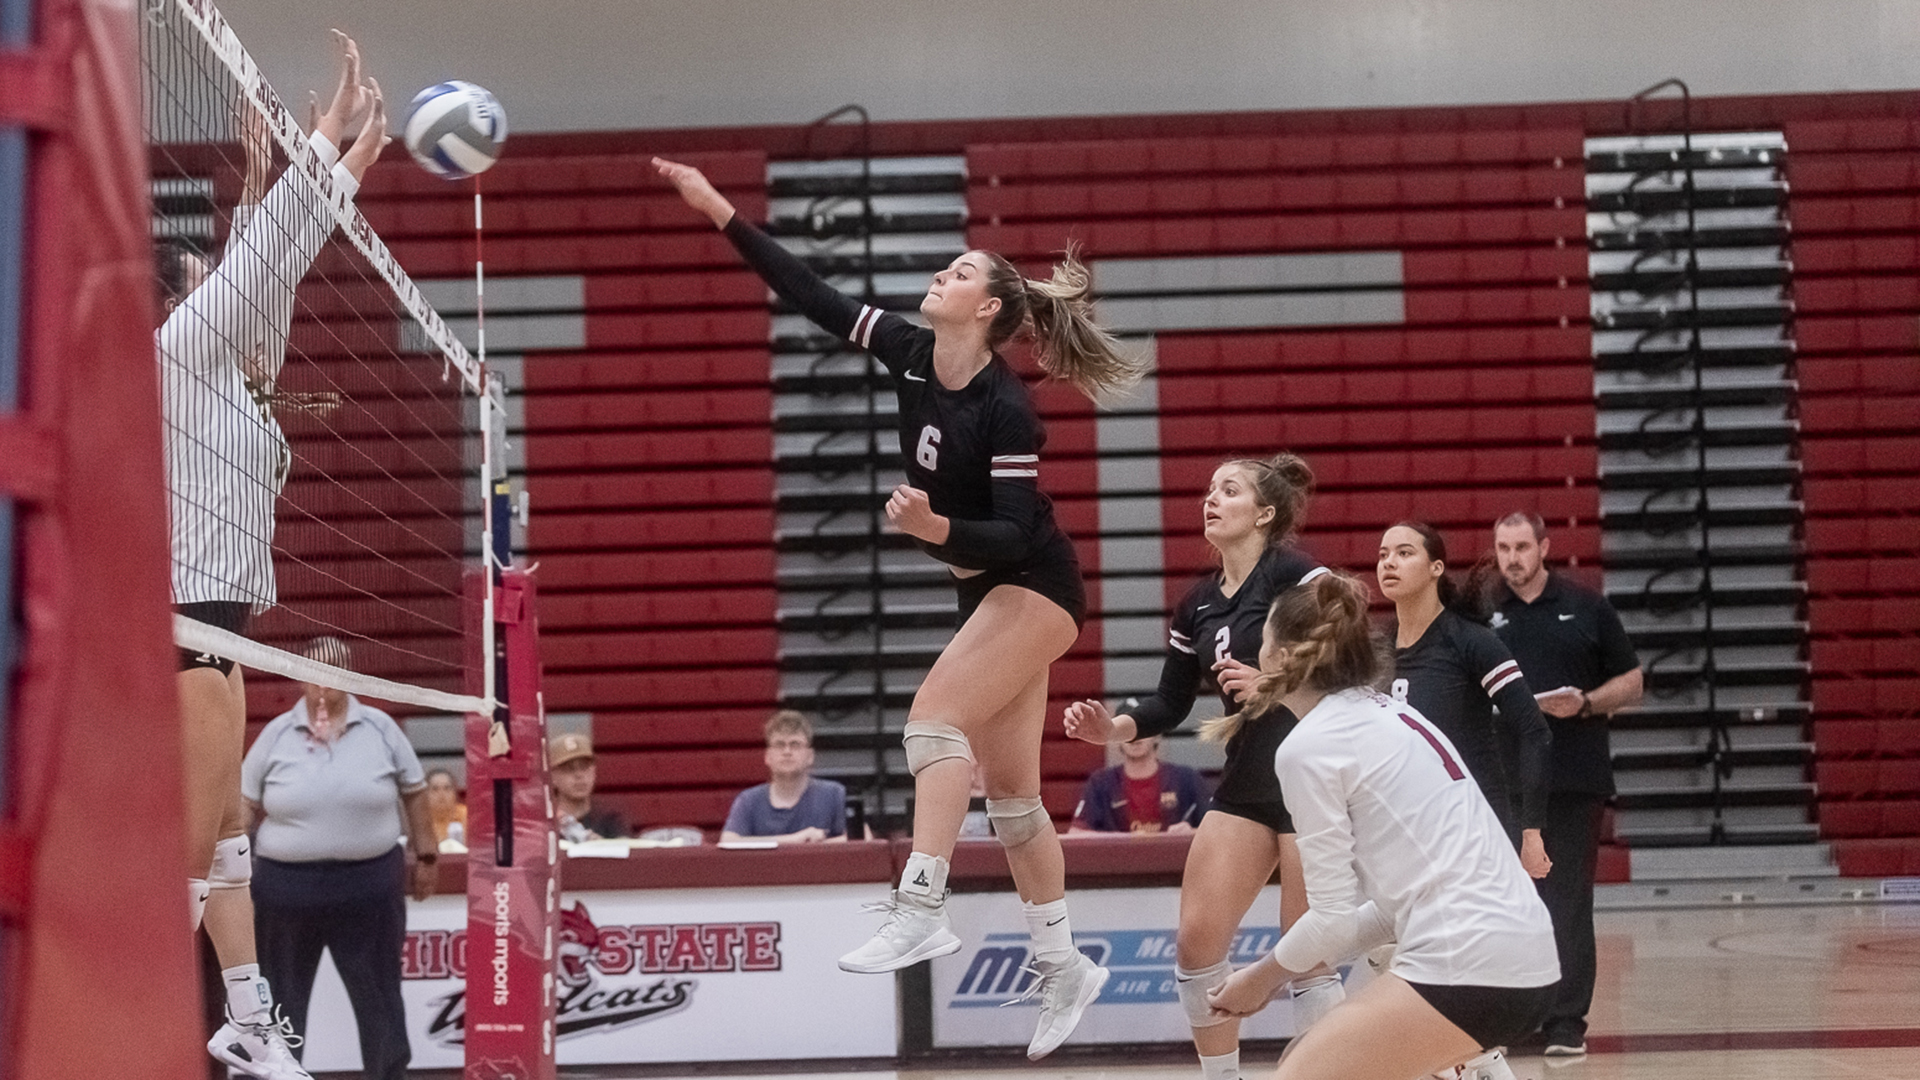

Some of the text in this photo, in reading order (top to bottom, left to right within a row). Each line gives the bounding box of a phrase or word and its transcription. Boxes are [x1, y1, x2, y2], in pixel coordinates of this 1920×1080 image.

[917, 424, 942, 471] 6
[1215, 625, 1232, 661] 2
[1397, 713, 1466, 781] 1
[491, 882, 511, 1006] sports imports
[597, 921, 782, 975] STATE
[1114, 980, 1151, 994] AIR
